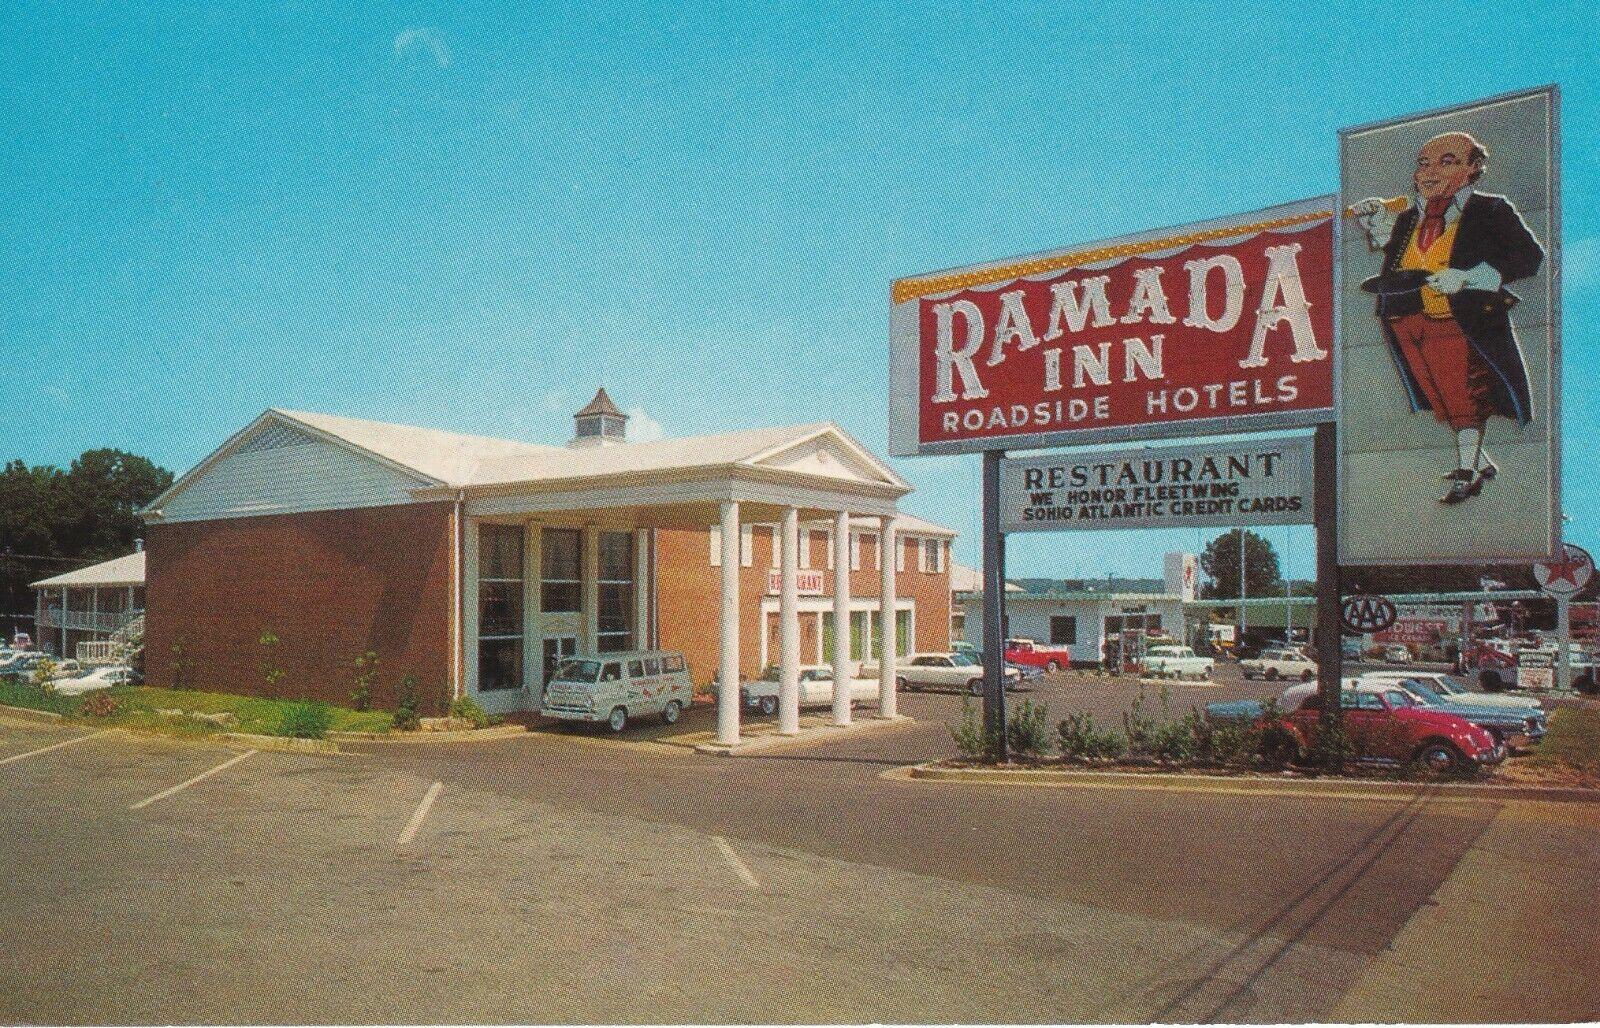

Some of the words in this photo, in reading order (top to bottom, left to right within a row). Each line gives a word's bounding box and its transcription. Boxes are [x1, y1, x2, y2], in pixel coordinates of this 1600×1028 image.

[930, 243, 1329, 404] RAMADA
[1043, 335, 1166, 392] INN
[942, 396, 1110, 434] ROADSIDE
[1147, 375, 1299, 415] HOTELS
[1024, 452, 1281, 490] RESTAURANT
[1023, 506, 1073, 521] SOHIO
[1079, 502, 1164, 520] ATLANTIC
[1169, 499, 1233, 515] CREDIT
[1238, 496, 1302, 513] CARDS
[1029, 492, 1053, 505] WE
[1067, 488, 1126, 504] HONOR
[1133, 482, 1240, 502] FLEETWING
[1346, 597, 1388, 631] AAA
